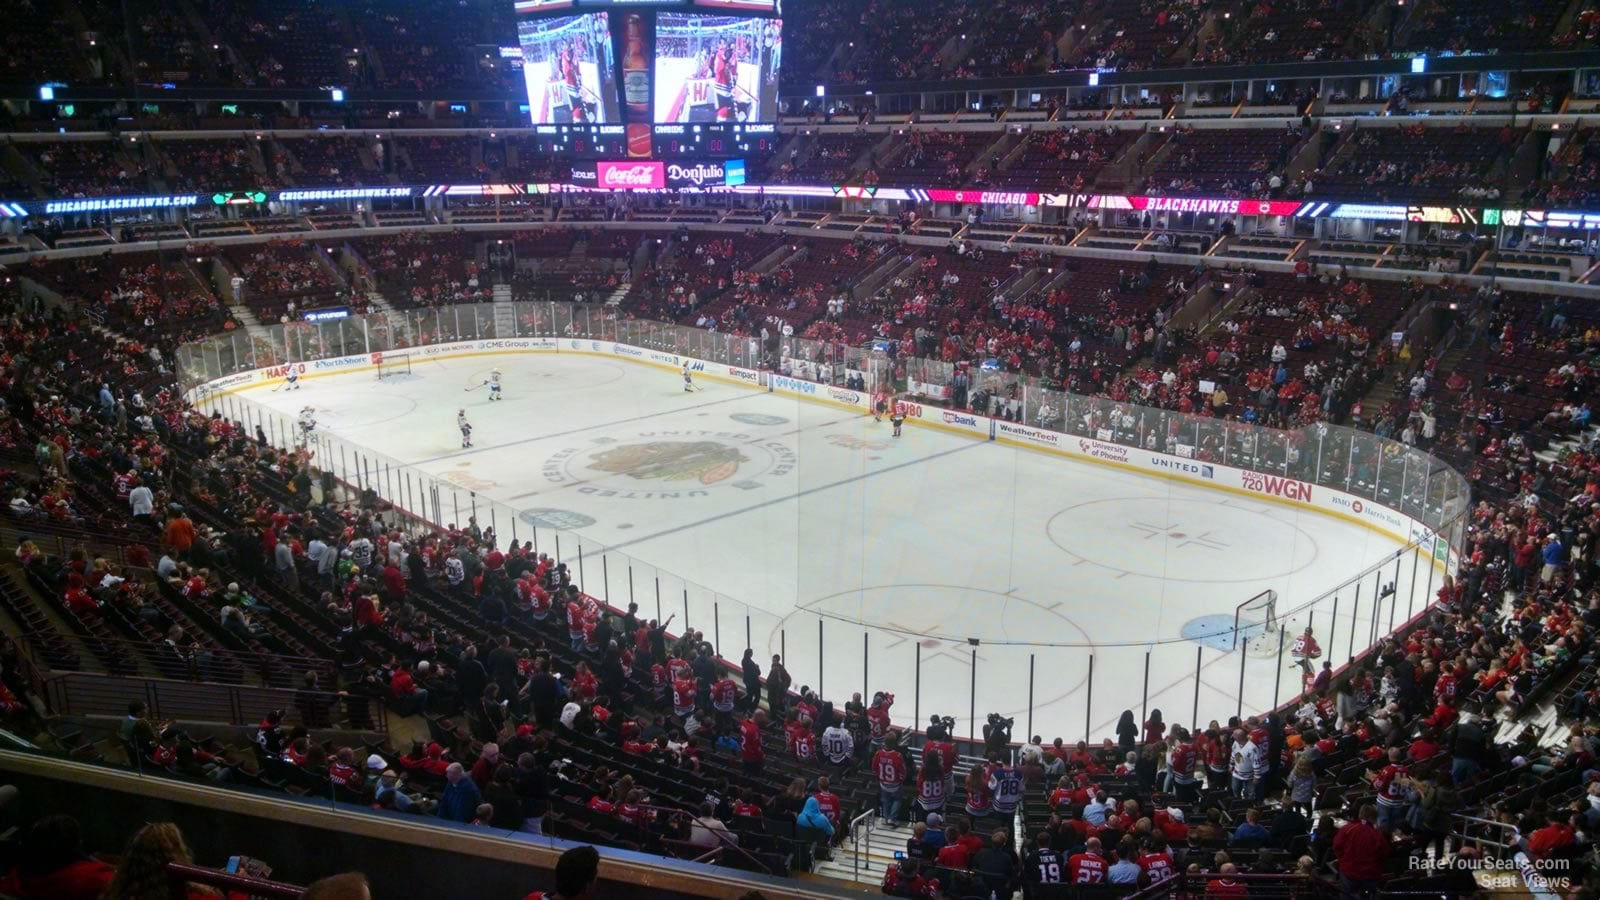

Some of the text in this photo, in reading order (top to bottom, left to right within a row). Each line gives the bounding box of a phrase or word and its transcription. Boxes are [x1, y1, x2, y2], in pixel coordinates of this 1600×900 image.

[279, 187, 411, 202] CHICAGOBLACKHAWKS.COM
[981, 192, 1027, 205] CHICAGO
[46, 195, 197, 214] CHICAGOBLACKHAWKS.COM
[1146, 198, 1240, 214] BLACKHAWKS
[486, 341, 504, 349] CME
[505, 341, 530, 350] Group
[650, 353, 673, 363] UNITED
[1000, 423, 1058, 442] WeatherTech
[1092, 440, 1128, 455] University
[765, 441, 797, 477] CENTER
[1091, 449, 1129, 464] of Phoenix
[1151, 457, 1199, 473] UNITED
[1242, 470, 1263, 481] RADIO
[1242, 475, 1312, 502] 720 WGN
[1332, 496, 1351, 508] BMO
[796, 741, 809, 758] 19
[829, 739, 844, 754] 10
[879, 763, 895, 781] 19
[923, 781, 942, 797] 88
[1000, 779, 1019, 796] 88
[1038, 863, 1060, 883] 19
